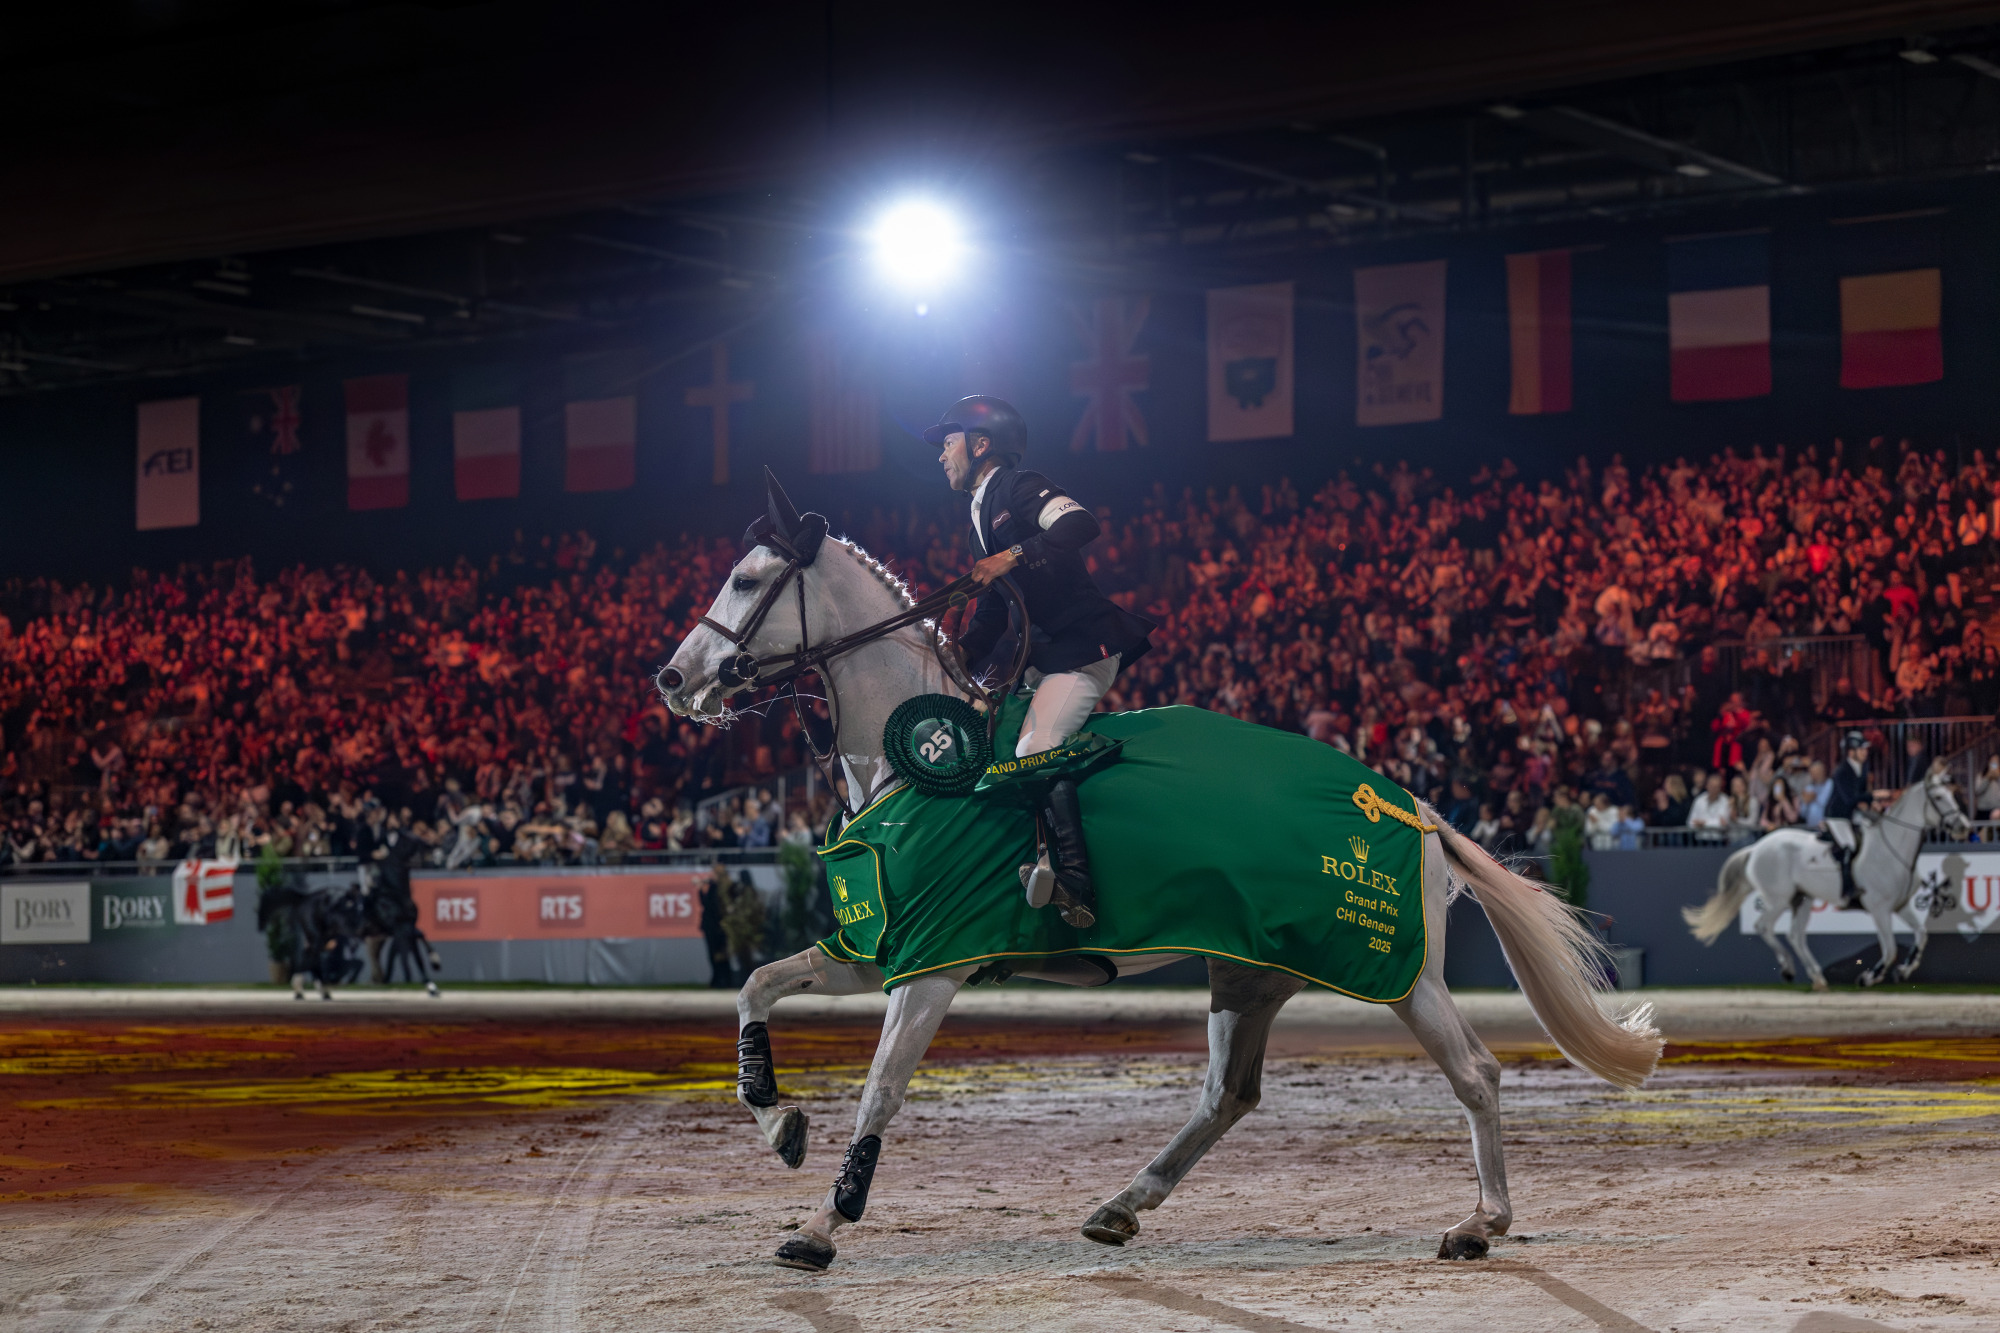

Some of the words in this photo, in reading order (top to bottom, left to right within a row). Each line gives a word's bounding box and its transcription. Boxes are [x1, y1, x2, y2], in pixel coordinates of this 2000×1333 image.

[1020, 753, 1049, 769] PRIX
[1321, 854, 1400, 897] ROLEX
[15, 897, 74, 931] BORY
[102, 894, 167, 930] BORY
[436, 897, 477, 922] RTS
[540, 894, 583, 920] RTS
[649, 892, 692, 918] RTS
[1345, 889, 1377, 911] Grand
[1379, 899, 1399, 918] Prix
[1336, 906, 1356, 924] CHI
[1358, 912, 1395, 936] Geneva
[1368, 936, 1391, 954] 2025
